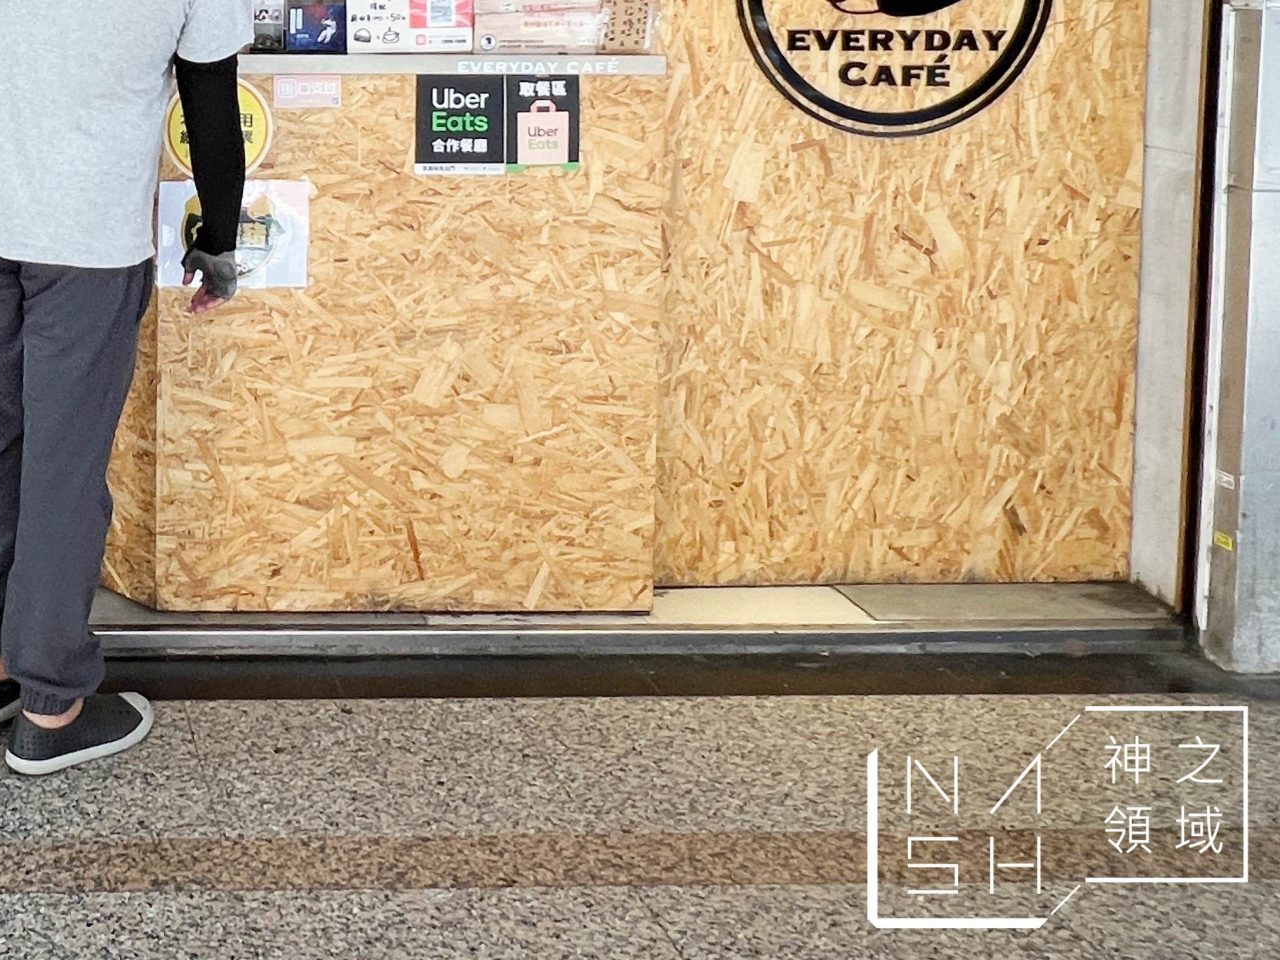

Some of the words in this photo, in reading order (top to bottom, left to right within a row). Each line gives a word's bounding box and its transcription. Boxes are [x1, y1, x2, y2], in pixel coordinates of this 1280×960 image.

[786, 29, 1008, 52] EVERYDAY
[457, 61, 558, 74] EVERYDAY
[566, 57, 620, 73] CAFÉ
[838, 55, 951, 87] CAFÉ
[431, 87, 490, 109] Uber
[519, 80, 567, 97] 取餐區
[431, 111, 489, 132] Eats
[527, 126, 559, 137] Uber
[528, 140, 558, 150] Eats
